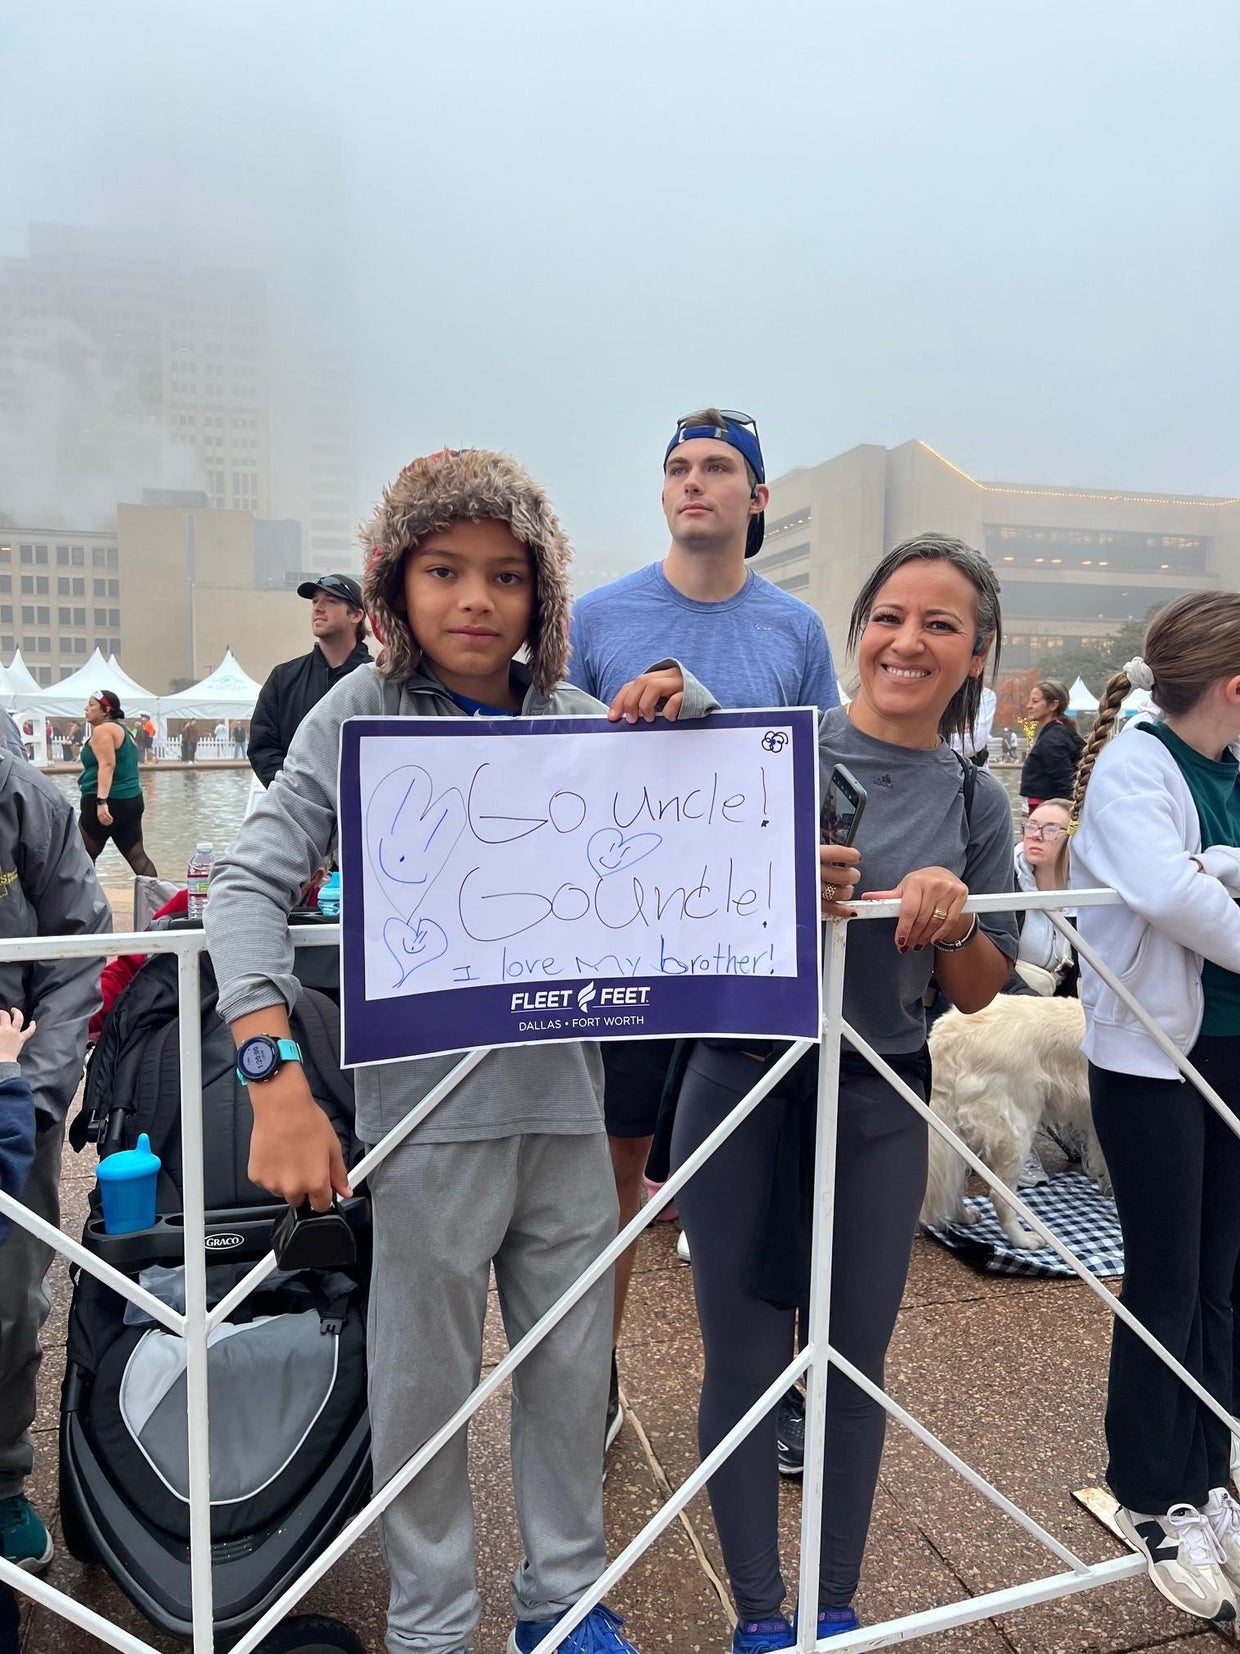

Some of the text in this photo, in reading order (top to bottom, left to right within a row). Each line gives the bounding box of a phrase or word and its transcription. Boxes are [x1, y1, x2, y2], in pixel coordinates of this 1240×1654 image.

[453, 964, 480, 982] I
[502, 946, 564, 982] love
[653, 934, 775, 976] brother!
[510, 986, 651, 1011] FLEET FEET
[519, 1015, 644, 1032] DALLAS FORT WORTH
[205, 1236, 240, 1247] GRACO
